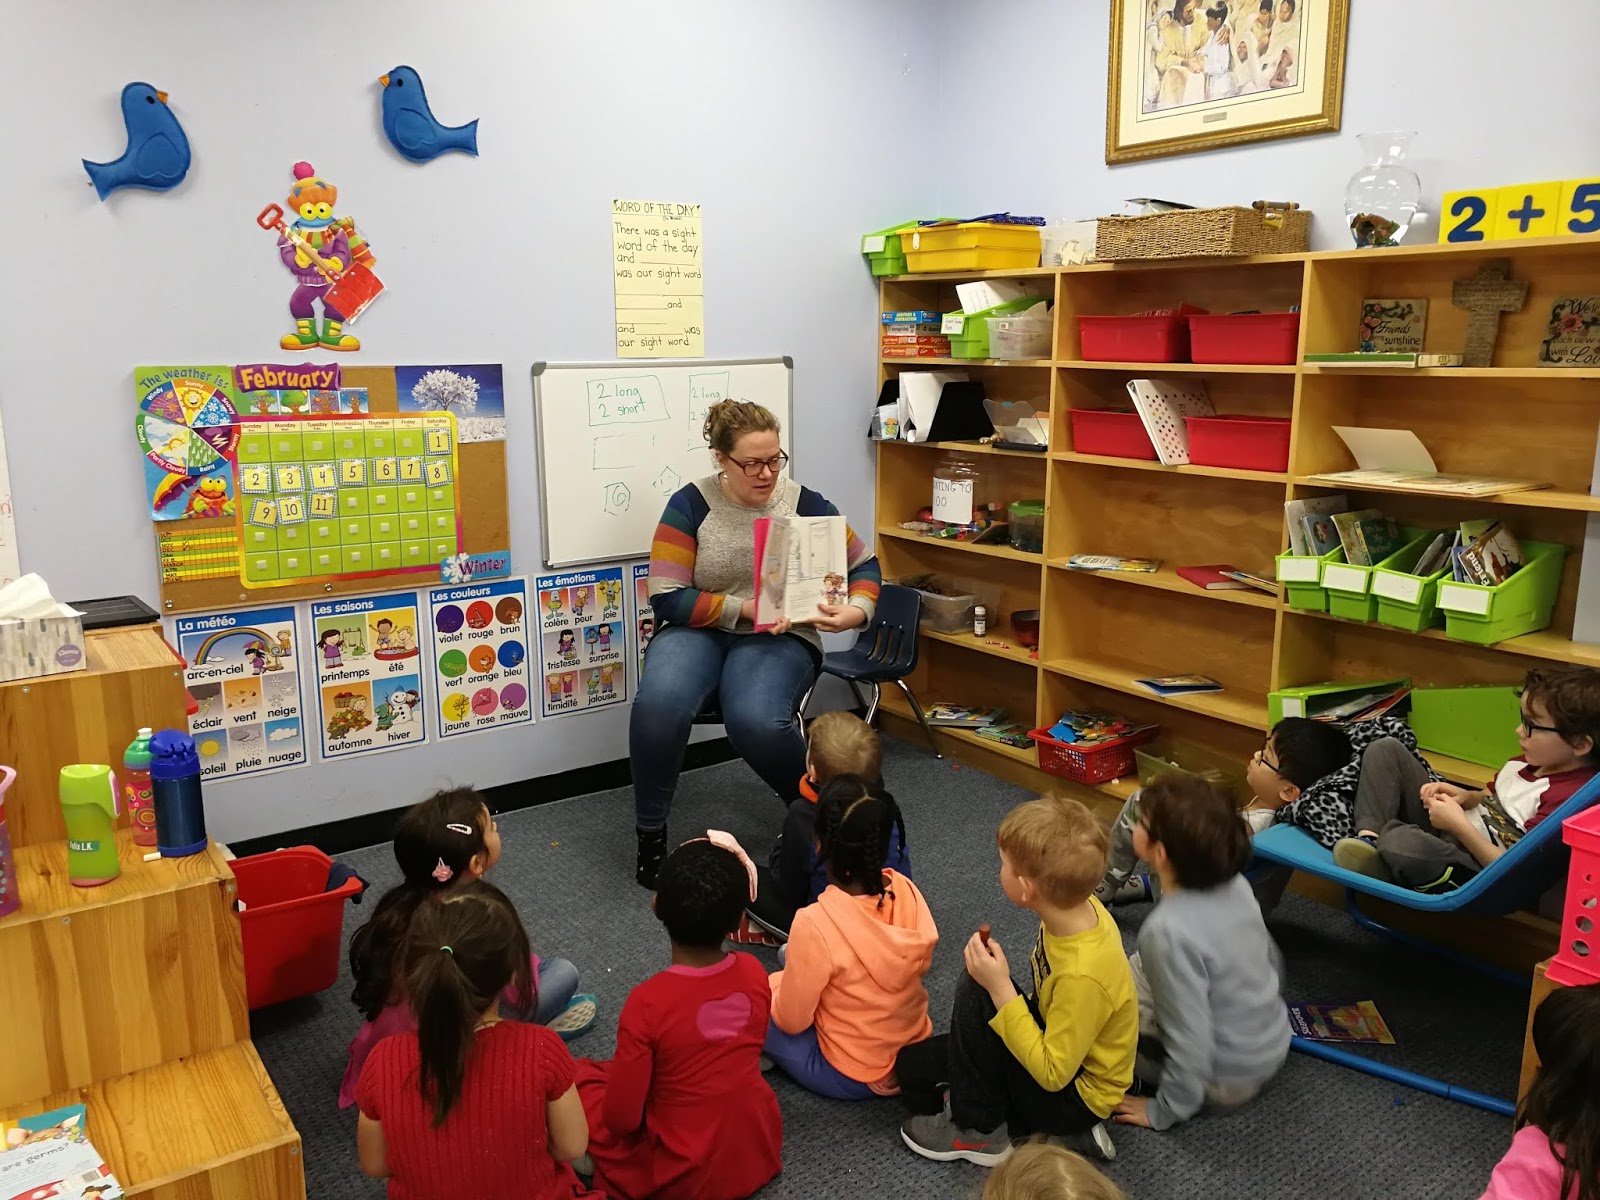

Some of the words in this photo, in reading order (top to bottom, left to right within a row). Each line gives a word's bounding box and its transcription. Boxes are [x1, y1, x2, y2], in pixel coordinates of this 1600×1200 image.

[615, 201, 640, 212] WORD
[644, 203, 654, 213] OF
[656, 204, 673, 215] THE
[676, 204, 695, 216] DAY
[1448, 196, 1486, 242] 2
[1568, 184, 1600, 233] 5
[614, 222, 639, 234] There
[644, 228, 659, 236] was
[672, 227, 696, 242] sight
[617, 238, 642, 251] word
[646, 239, 657, 251] of
[663, 241, 678, 253] the
[682, 241, 698, 258] day
[617, 253, 634, 263] and
[616, 268, 632, 278] was
[637, 270, 652, 278] our
[658, 268, 681, 285] sight
[684, 268, 701, 279] word
[667, 299, 682, 308] and
[618, 323, 635, 333] and
[684, 326, 701, 335] was
[1376, 320, 1411, 334] Friends
[619, 338, 634, 346] our
[641, 337, 662, 351] sight
[1384, 336, 1420, 345] sunshine
[1552, 346, 1568, 356] with
[139, 374, 162, 388] The
[163, 368, 212, 380] weather
[241, 366, 334, 389] February
[147, 387, 164, 401] Windy
[597, 383, 612, 399] 2
[616, 384, 642, 401] long
[692, 387, 698, 398] 2
[702, 387, 720, 400] long
[221, 398, 235, 415] Snowy
[599, 404, 610, 417] 2
[618, 401, 646, 415] short
[691, 412, 696, 420] 2
[138, 424, 146, 443] Cloudy
[436, 436, 442, 448] 1
[150, 452, 165, 467] Partly
[166, 462, 186, 474] Cloudy
[200, 464, 215, 472] Rainy
[252, 474, 260, 486] 2
[286, 473, 294, 484] 3
[319, 471, 326, 483] 4
[350, 466, 357, 478] 5
[382, 464, 390, 476] 6
[407, 464, 414, 475] 7
[434, 467, 441, 479] 8
[959, 484, 971, 493] TO
[262, 507, 270, 520] 9
[286, 504, 298, 516] 10
[316, 499, 327, 511] 11
[458, 558, 506, 576] Winter
[635, 568, 649, 576] Les
[538, 579, 553, 588] Les
[555, 573, 596, 585] émotions
[432, 592, 448, 602] Les
[451, 586, 491, 599] couleurs
[314, 605, 332, 615] Les
[335, 600, 374, 612] saisons
[179, 620, 193, 631] La
[197, 616, 236, 630] météo
[544, 617, 569, 628] colère
[574, 615, 593, 625] peur
[602, 610, 617, 621] joie
[438, 632, 463, 644] violet
[468, 629, 494, 640] rouge
[500, 624, 520, 635] brun
[547, 658, 581, 670] tristesse
[589, 652, 619, 663] surprise
[187, 664, 244, 680] arc-en-ciel
[321, 667, 370, 684] printemps
[388, 662, 404, 672] été
[445, 677, 463, 687] vert
[468, 672, 499, 684] orange
[504, 667, 522, 677] bleu
[548, 699, 578, 711] timidité
[588, 692, 617, 704] jalousie
[193, 717, 223, 730] éclair
[234, 712, 257, 723] vent
[267, 705, 297, 720] neige
[444, 720, 470, 733] jaune
[477, 716, 495, 726] rose
[500, 709, 528, 721] mauve
[328, 737, 372, 751] automne
[388, 730, 411, 742] hiver
[200, 763, 226, 775] soleil
[236, 757, 262, 771] pluie
[268, 750, 301, 764] nuage
[2, 1162, 21, 1171] are
[26, 1143, 69, 1164] germs?
